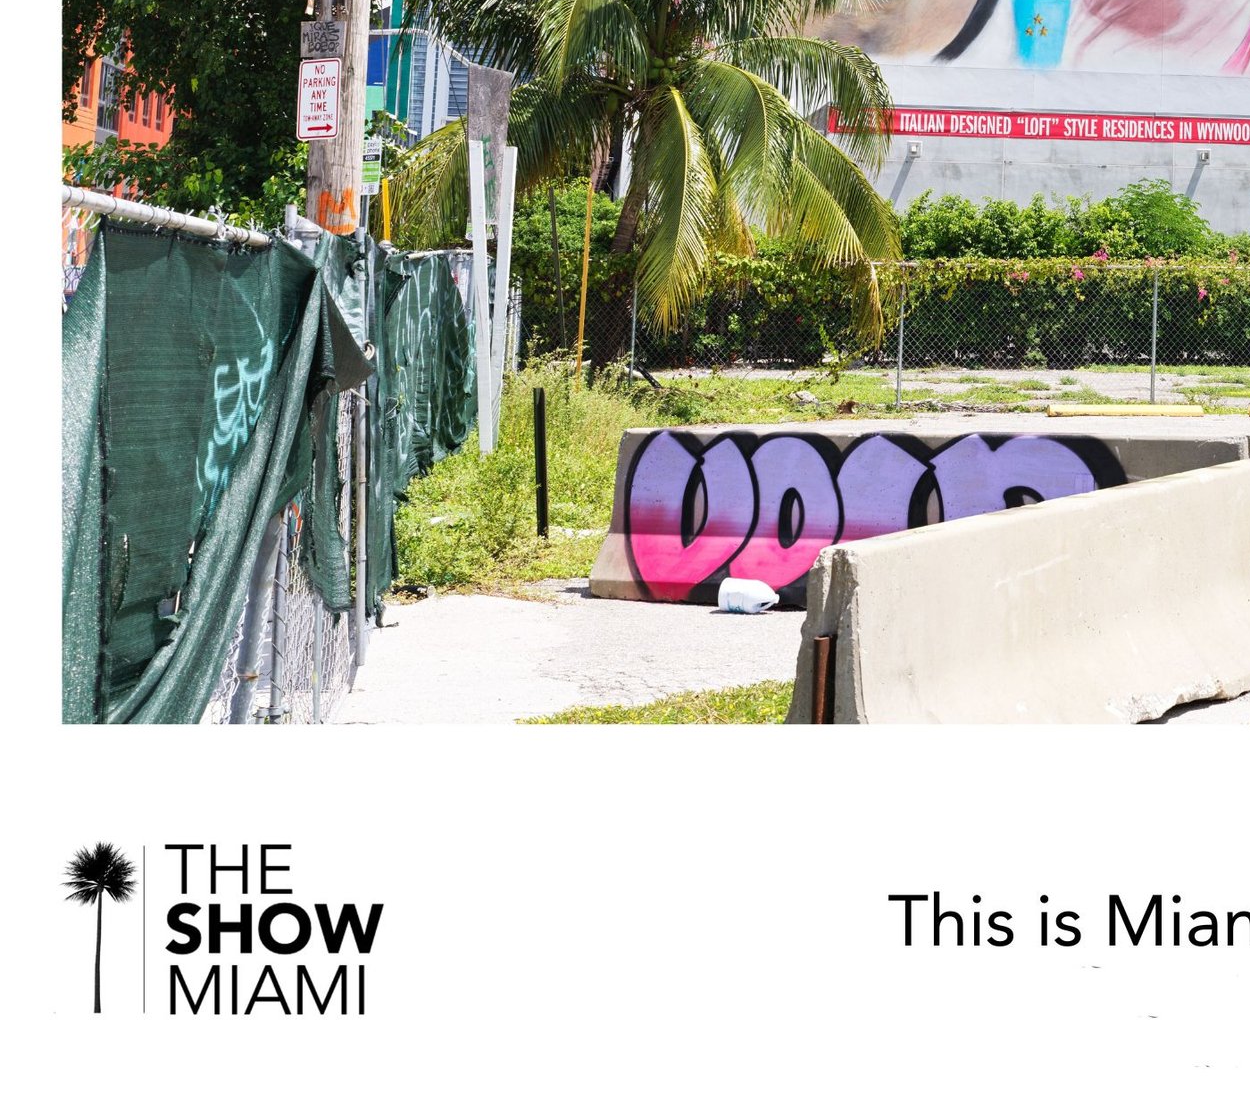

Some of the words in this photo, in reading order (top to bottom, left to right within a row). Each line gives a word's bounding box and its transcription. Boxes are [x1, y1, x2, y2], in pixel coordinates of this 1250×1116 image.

[314, 65, 326, 76] NO
[303, 77, 336, 88] PARKING
[311, 90, 326, 100] ANY
[310, 102, 328, 113] TIME
[900, 113, 945, 132] ITALIAN
[950, 115, 1012, 135] DESIGNED
[1063, 118, 1098, 138] STYLE
[1102, 119, 1174, 140] RESIDENCES
[1179, 122, 1192, 140] IN
